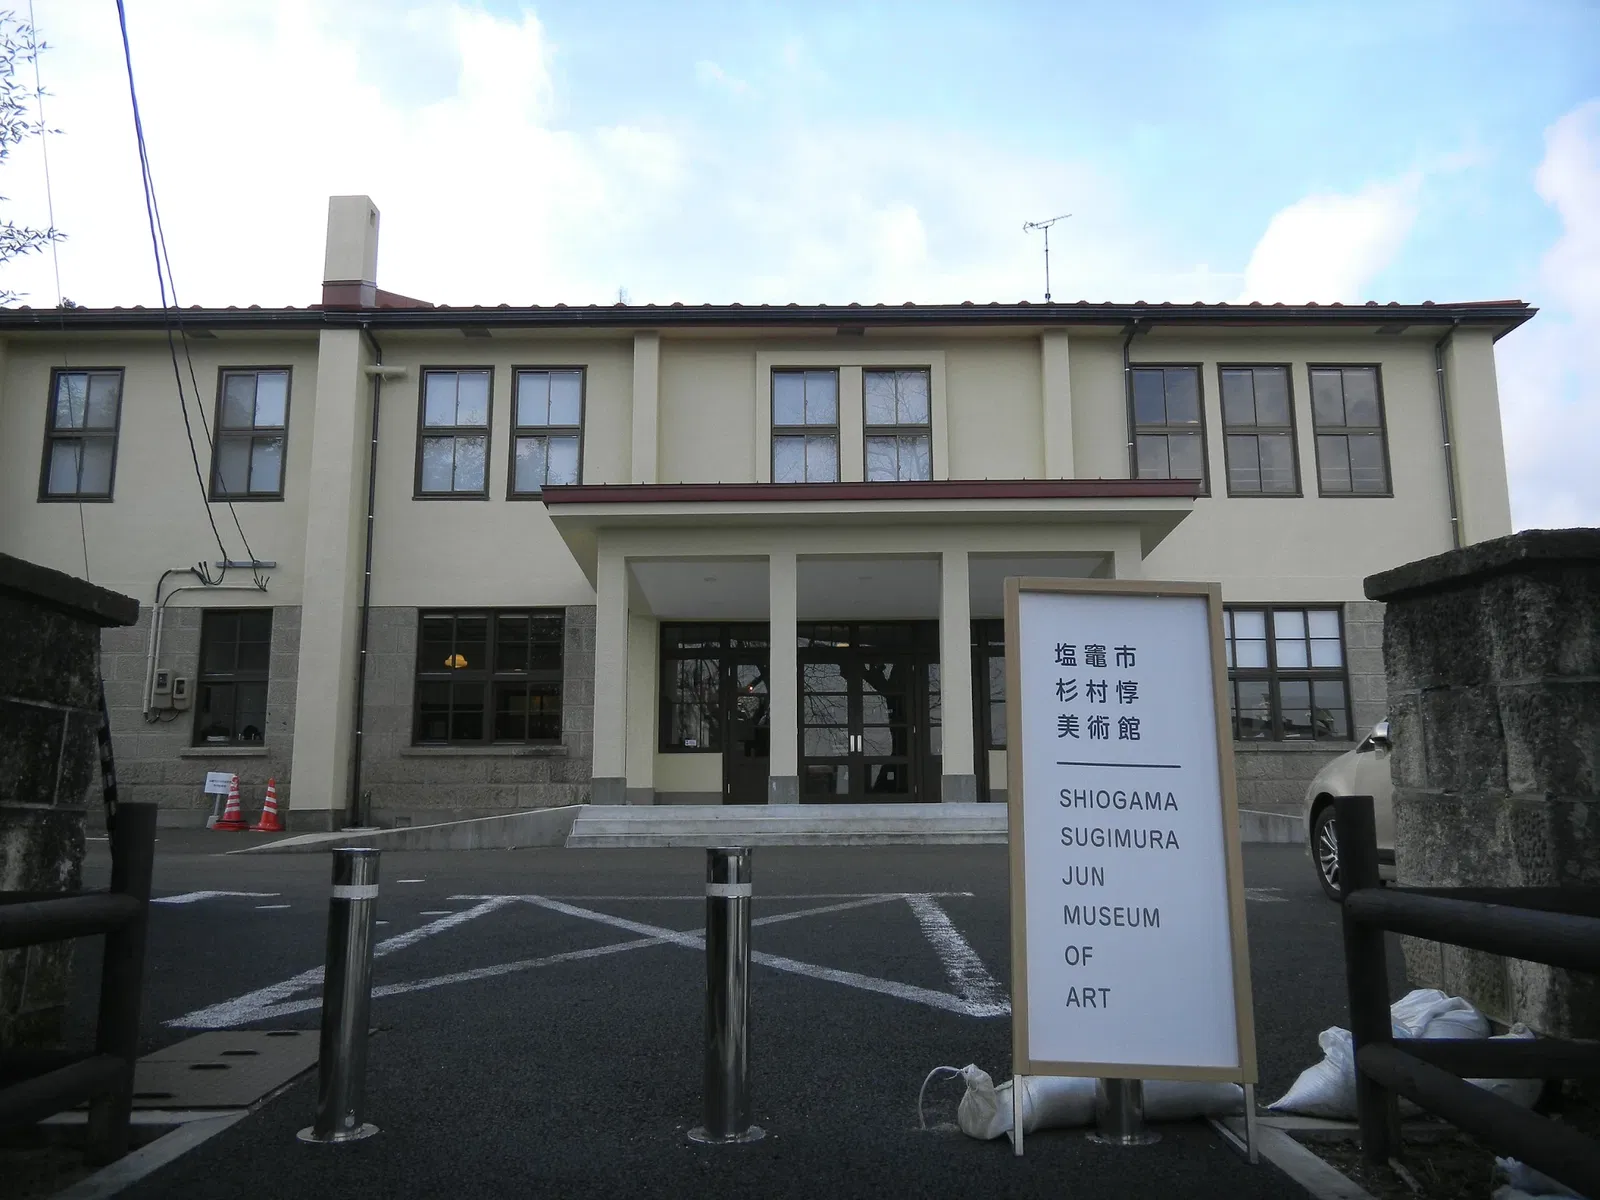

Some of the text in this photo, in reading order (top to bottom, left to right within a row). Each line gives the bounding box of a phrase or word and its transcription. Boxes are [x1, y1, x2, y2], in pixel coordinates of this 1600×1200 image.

[1054, 642, 1137, 669] 塩竈市
[1055, 677, 1139, 705] 杉村惇
[1057, 713, 1141, 741] 美術館
[1059, 788, 1179, 812] SHIOGAMA
[1060, 826, 1180, 850] SUGIMURA
[1061, 865, 1105, 887] JUN
[1063, 904, 1160, 929] MUSEUM
[1064, 945, 1093, 967] OF
[1065, 986, 1111, 1009] ART
